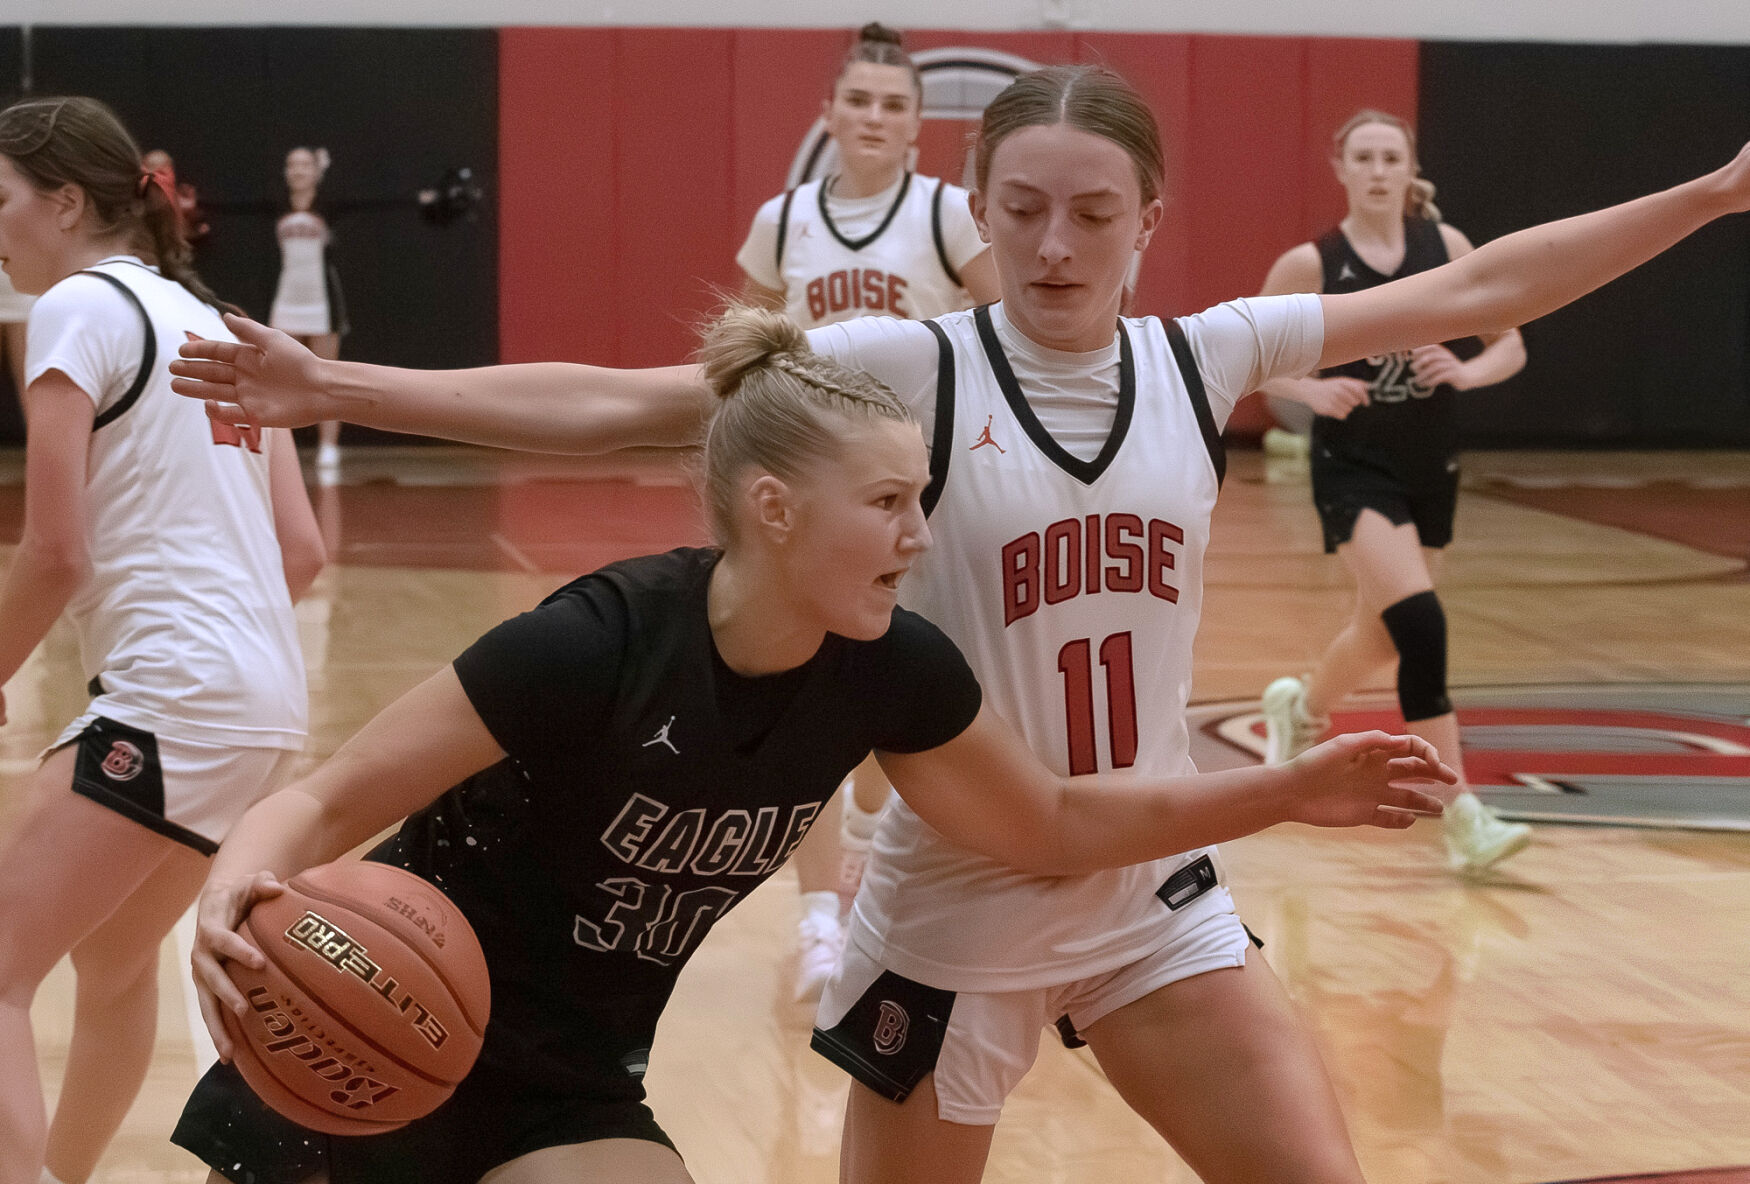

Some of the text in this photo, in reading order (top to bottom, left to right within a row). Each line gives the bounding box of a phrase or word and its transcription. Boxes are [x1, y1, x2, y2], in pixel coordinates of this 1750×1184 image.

[807, 268, 910, 322] BOISE
[1001, 512, 1185, 628] BOISE
[1057, 630, 1139, 777] 11
[600, 792, 822, 876] EAGLE
[291, 915, 450, 1051] ELITE PRO
[873, 1000, 911, 1056] B
[246, 986, 402, 1110] Baden
